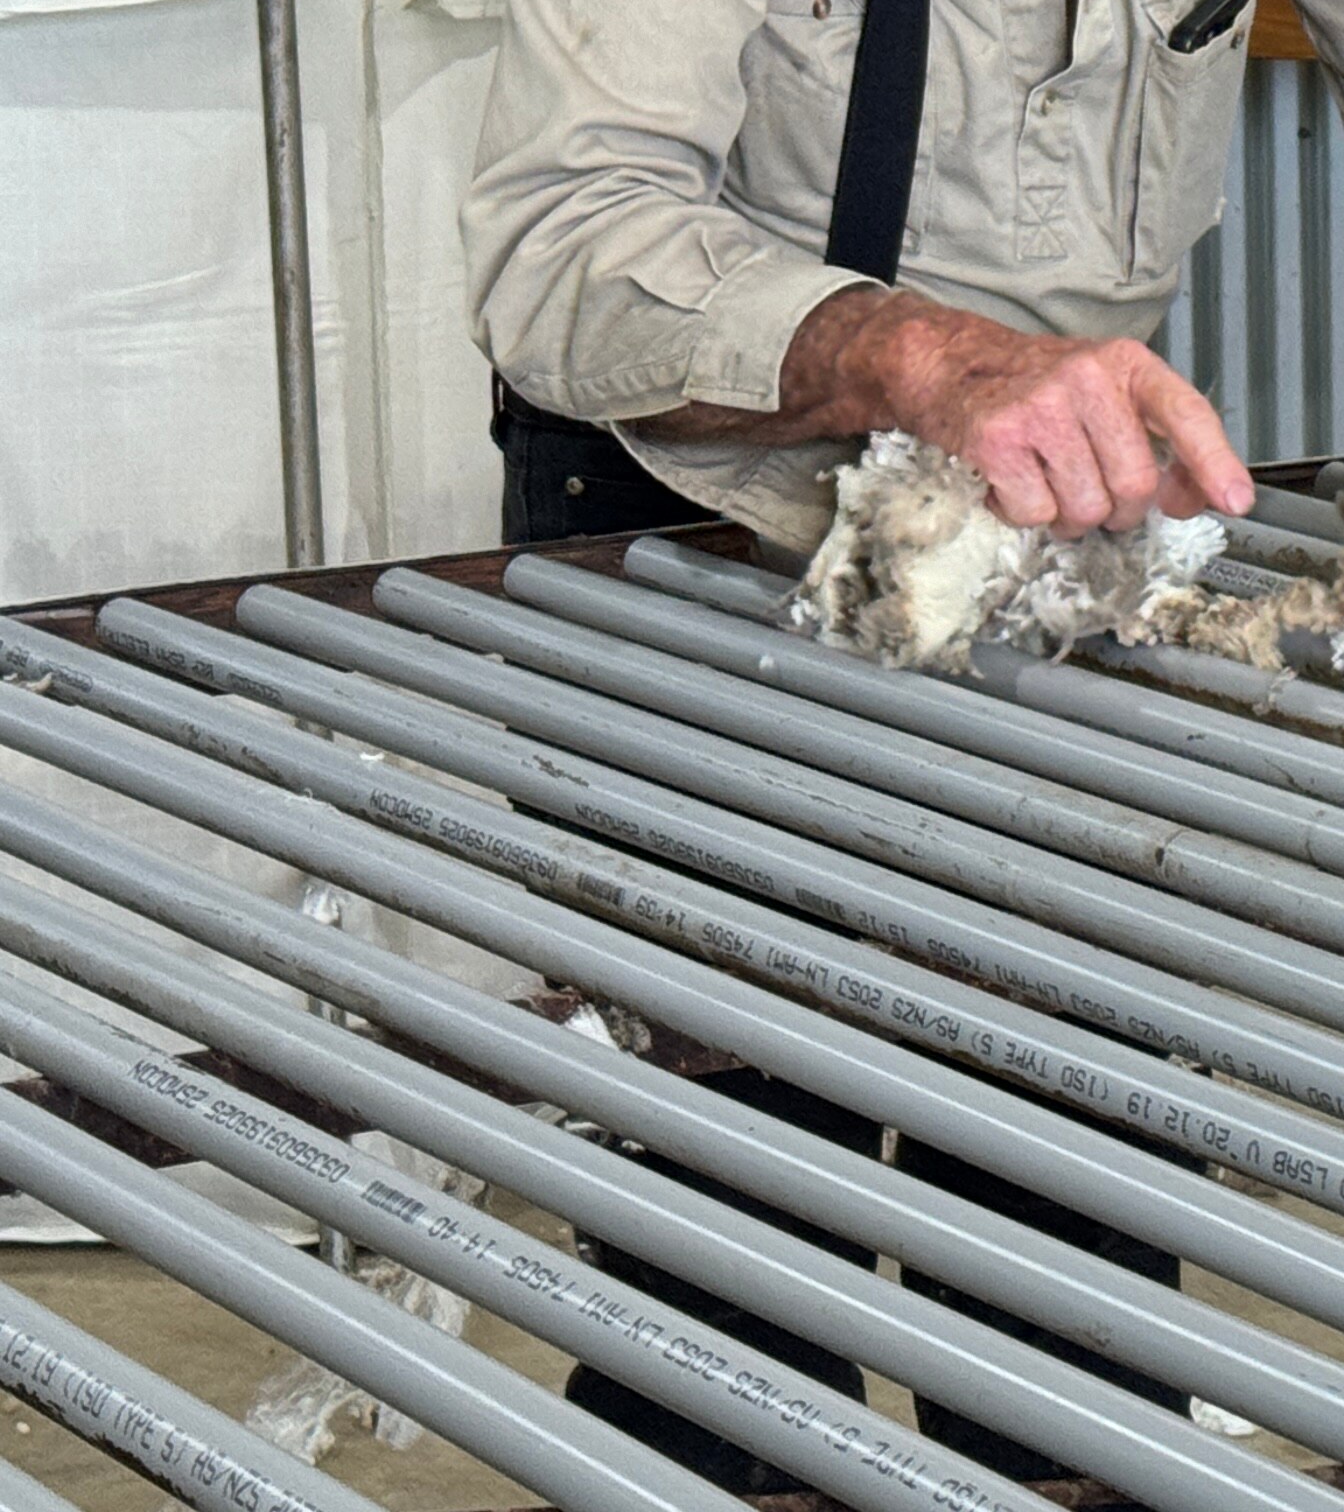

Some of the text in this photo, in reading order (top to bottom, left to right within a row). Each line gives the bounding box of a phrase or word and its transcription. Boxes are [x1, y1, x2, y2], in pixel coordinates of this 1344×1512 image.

[699, 921, 755, 960] 74505
[835, 973, 883, 1011] 2053
[889, 995, 961, 1042] AS/NZS
[968, 1028, 994, 1056] 5)
[1001, 1040, 1050, 1078] TYPE
[202, 1098, 351, 1183] 0935609199025
[501, 1252, 577, 1301] 74505
[659, 1336, 729, 1381] 2053
